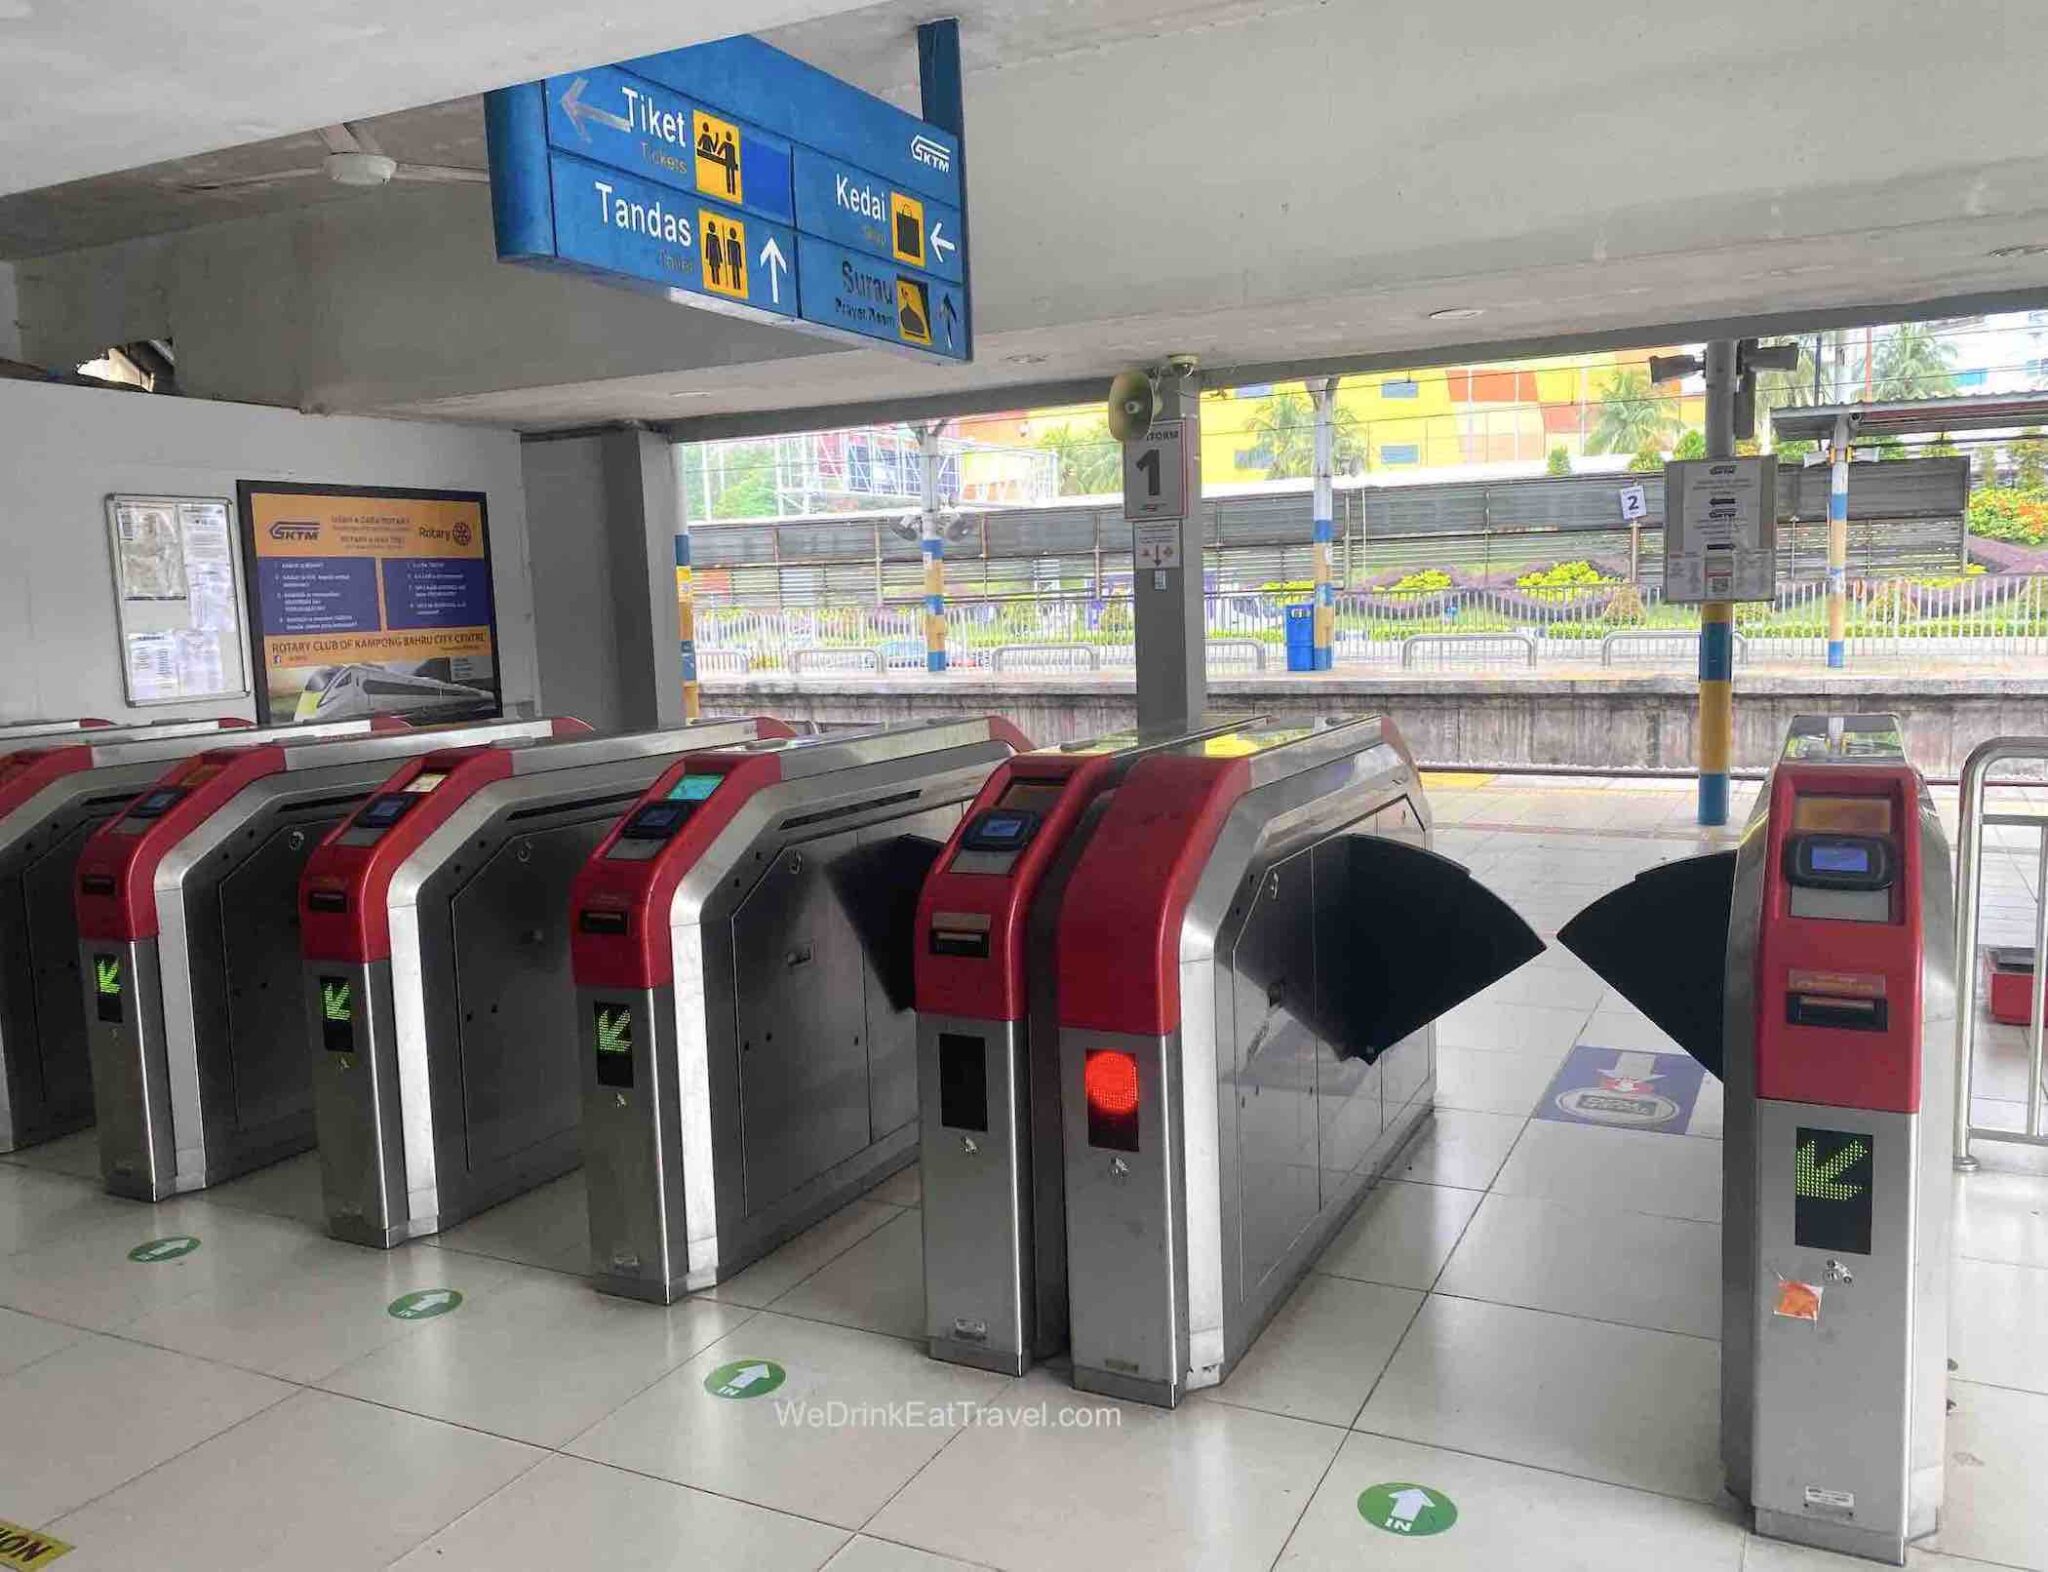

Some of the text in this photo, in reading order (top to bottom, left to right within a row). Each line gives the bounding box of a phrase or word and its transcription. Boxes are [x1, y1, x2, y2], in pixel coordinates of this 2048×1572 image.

[621, 86, 686, 148] Tiket
[836, 172, 886, 222] Kedai
[594, 181, 692, 247] Tandas
[842, 260, 893, 304] Surau
[1136, 449, 1160, 496] 1
[1627, 495, 1640, 510] 2
[418, 527, 450, 542] Rotary
[272, 640, 311, 653] ROTARY
[313, 639, 339, 652] CLUB
[341, 638, 353, 649] OF
[403, 634, 433, 647] BAHRU
[434, 633, 454, 645] CITY
[719, 1385, 741, 1397] IN
[1384, 1517, 1413, 1532] IN
